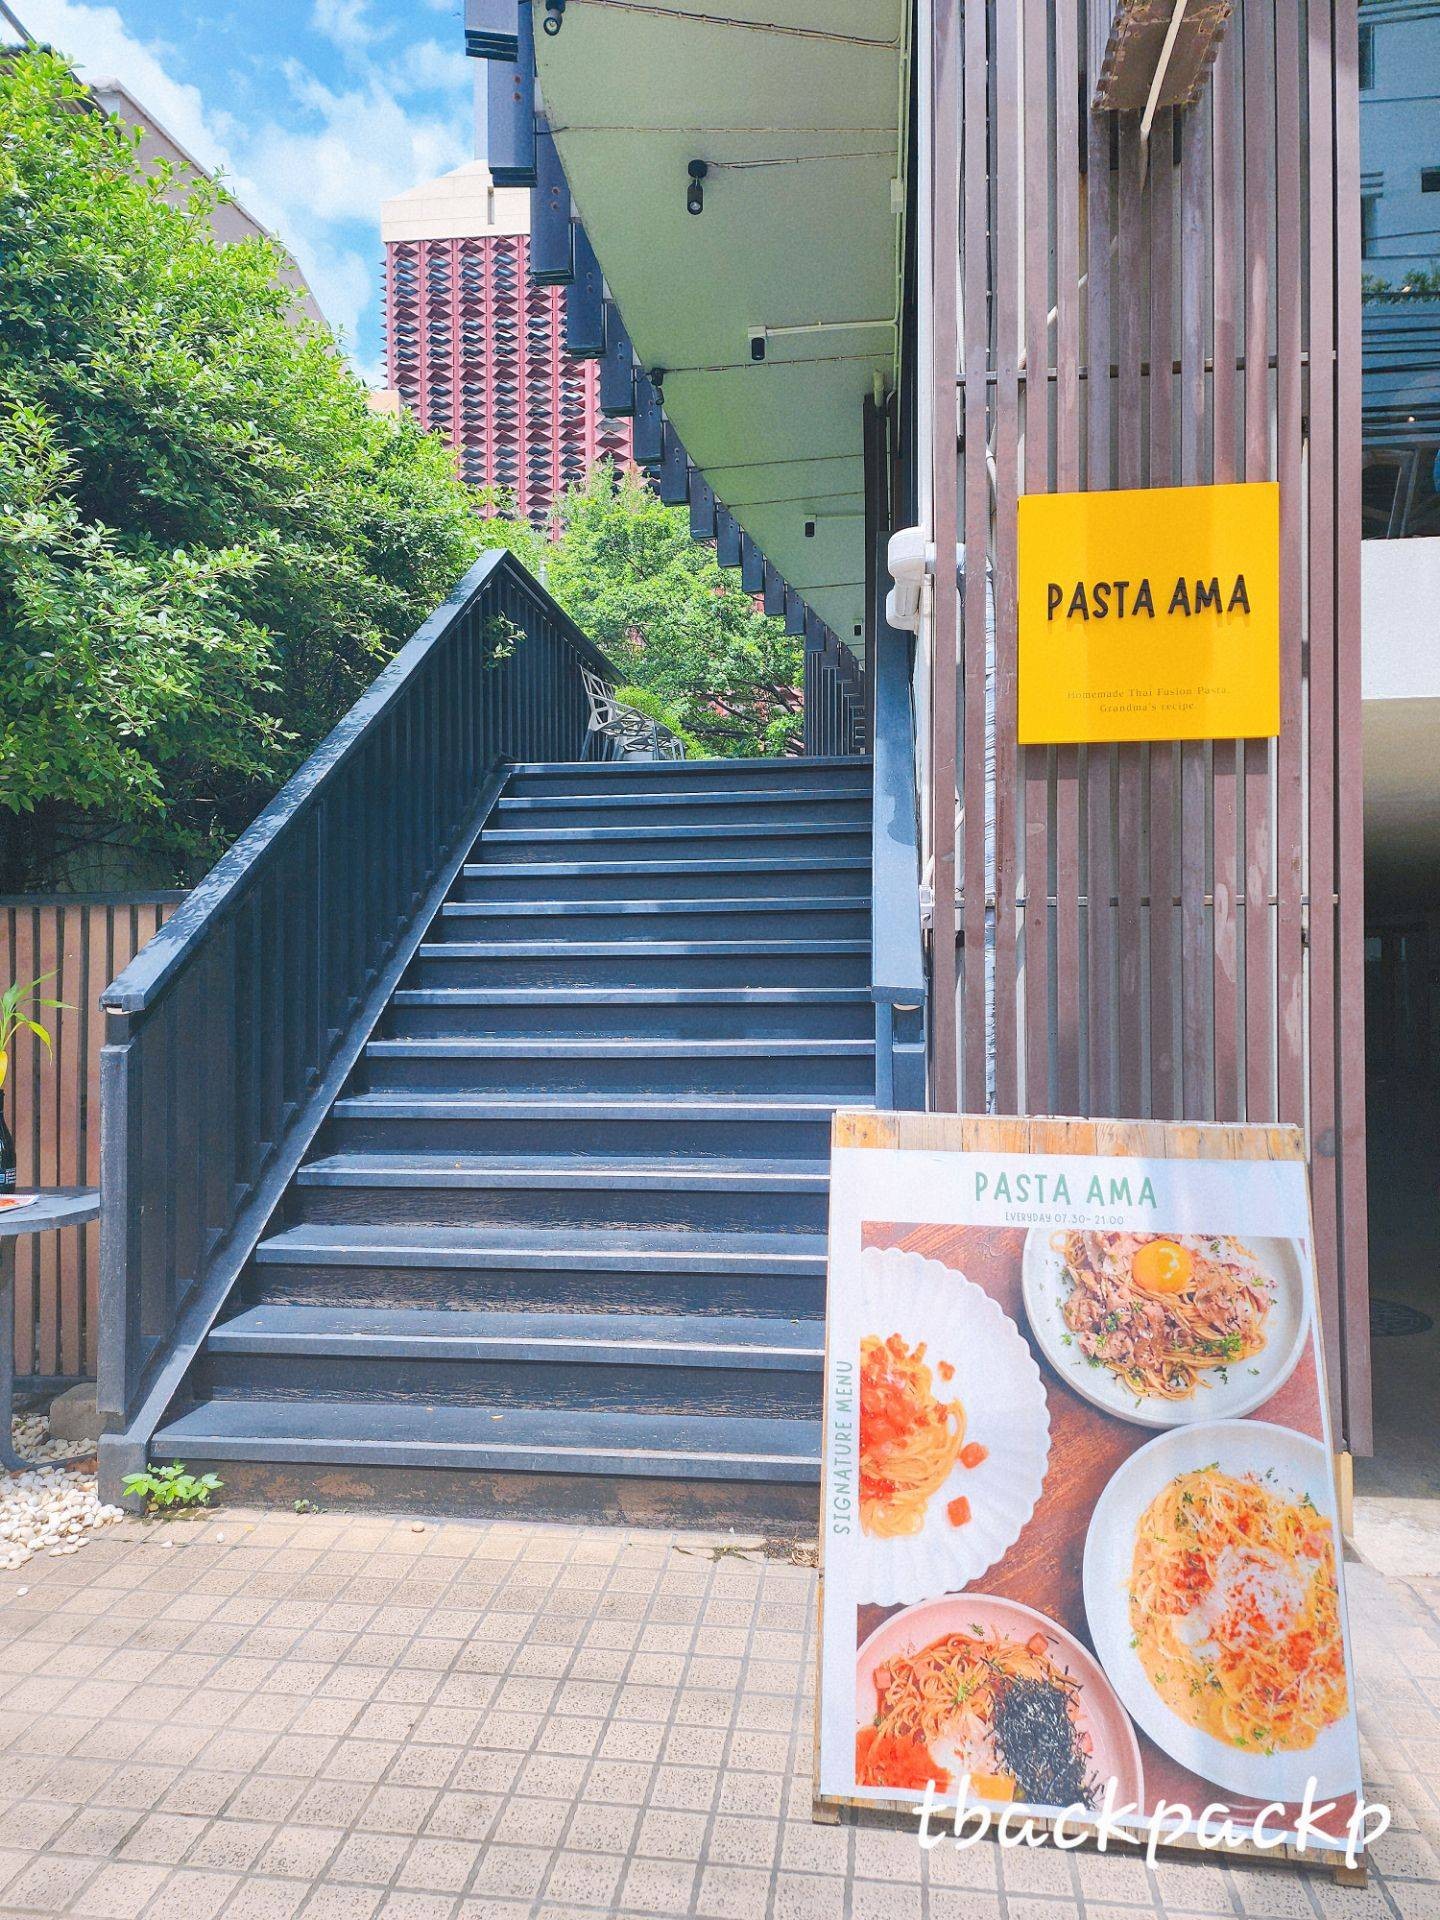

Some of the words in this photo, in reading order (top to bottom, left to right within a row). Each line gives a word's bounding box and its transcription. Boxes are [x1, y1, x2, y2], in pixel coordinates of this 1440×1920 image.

[1047, 578, 1155, 621] PASTA
[1168, 574, 1250, 616] AMA
[1067, 689, 1124, 699] Homemade
[1130, 688, 1152, 697] Thai
[1157, 687, 1192, 696] Fusion
[1100, 703, 1157, 713] Grandma's
[975, 1171, 1071, 1205] PASTA
[1086, 1174, 1157, 1208] AMA
[1005, 1212, 1051, 1222] EVERYDAY
[836, 1360, 852, 1413] MENU
[833, 1422, 852, 1535] SIGNATURE
